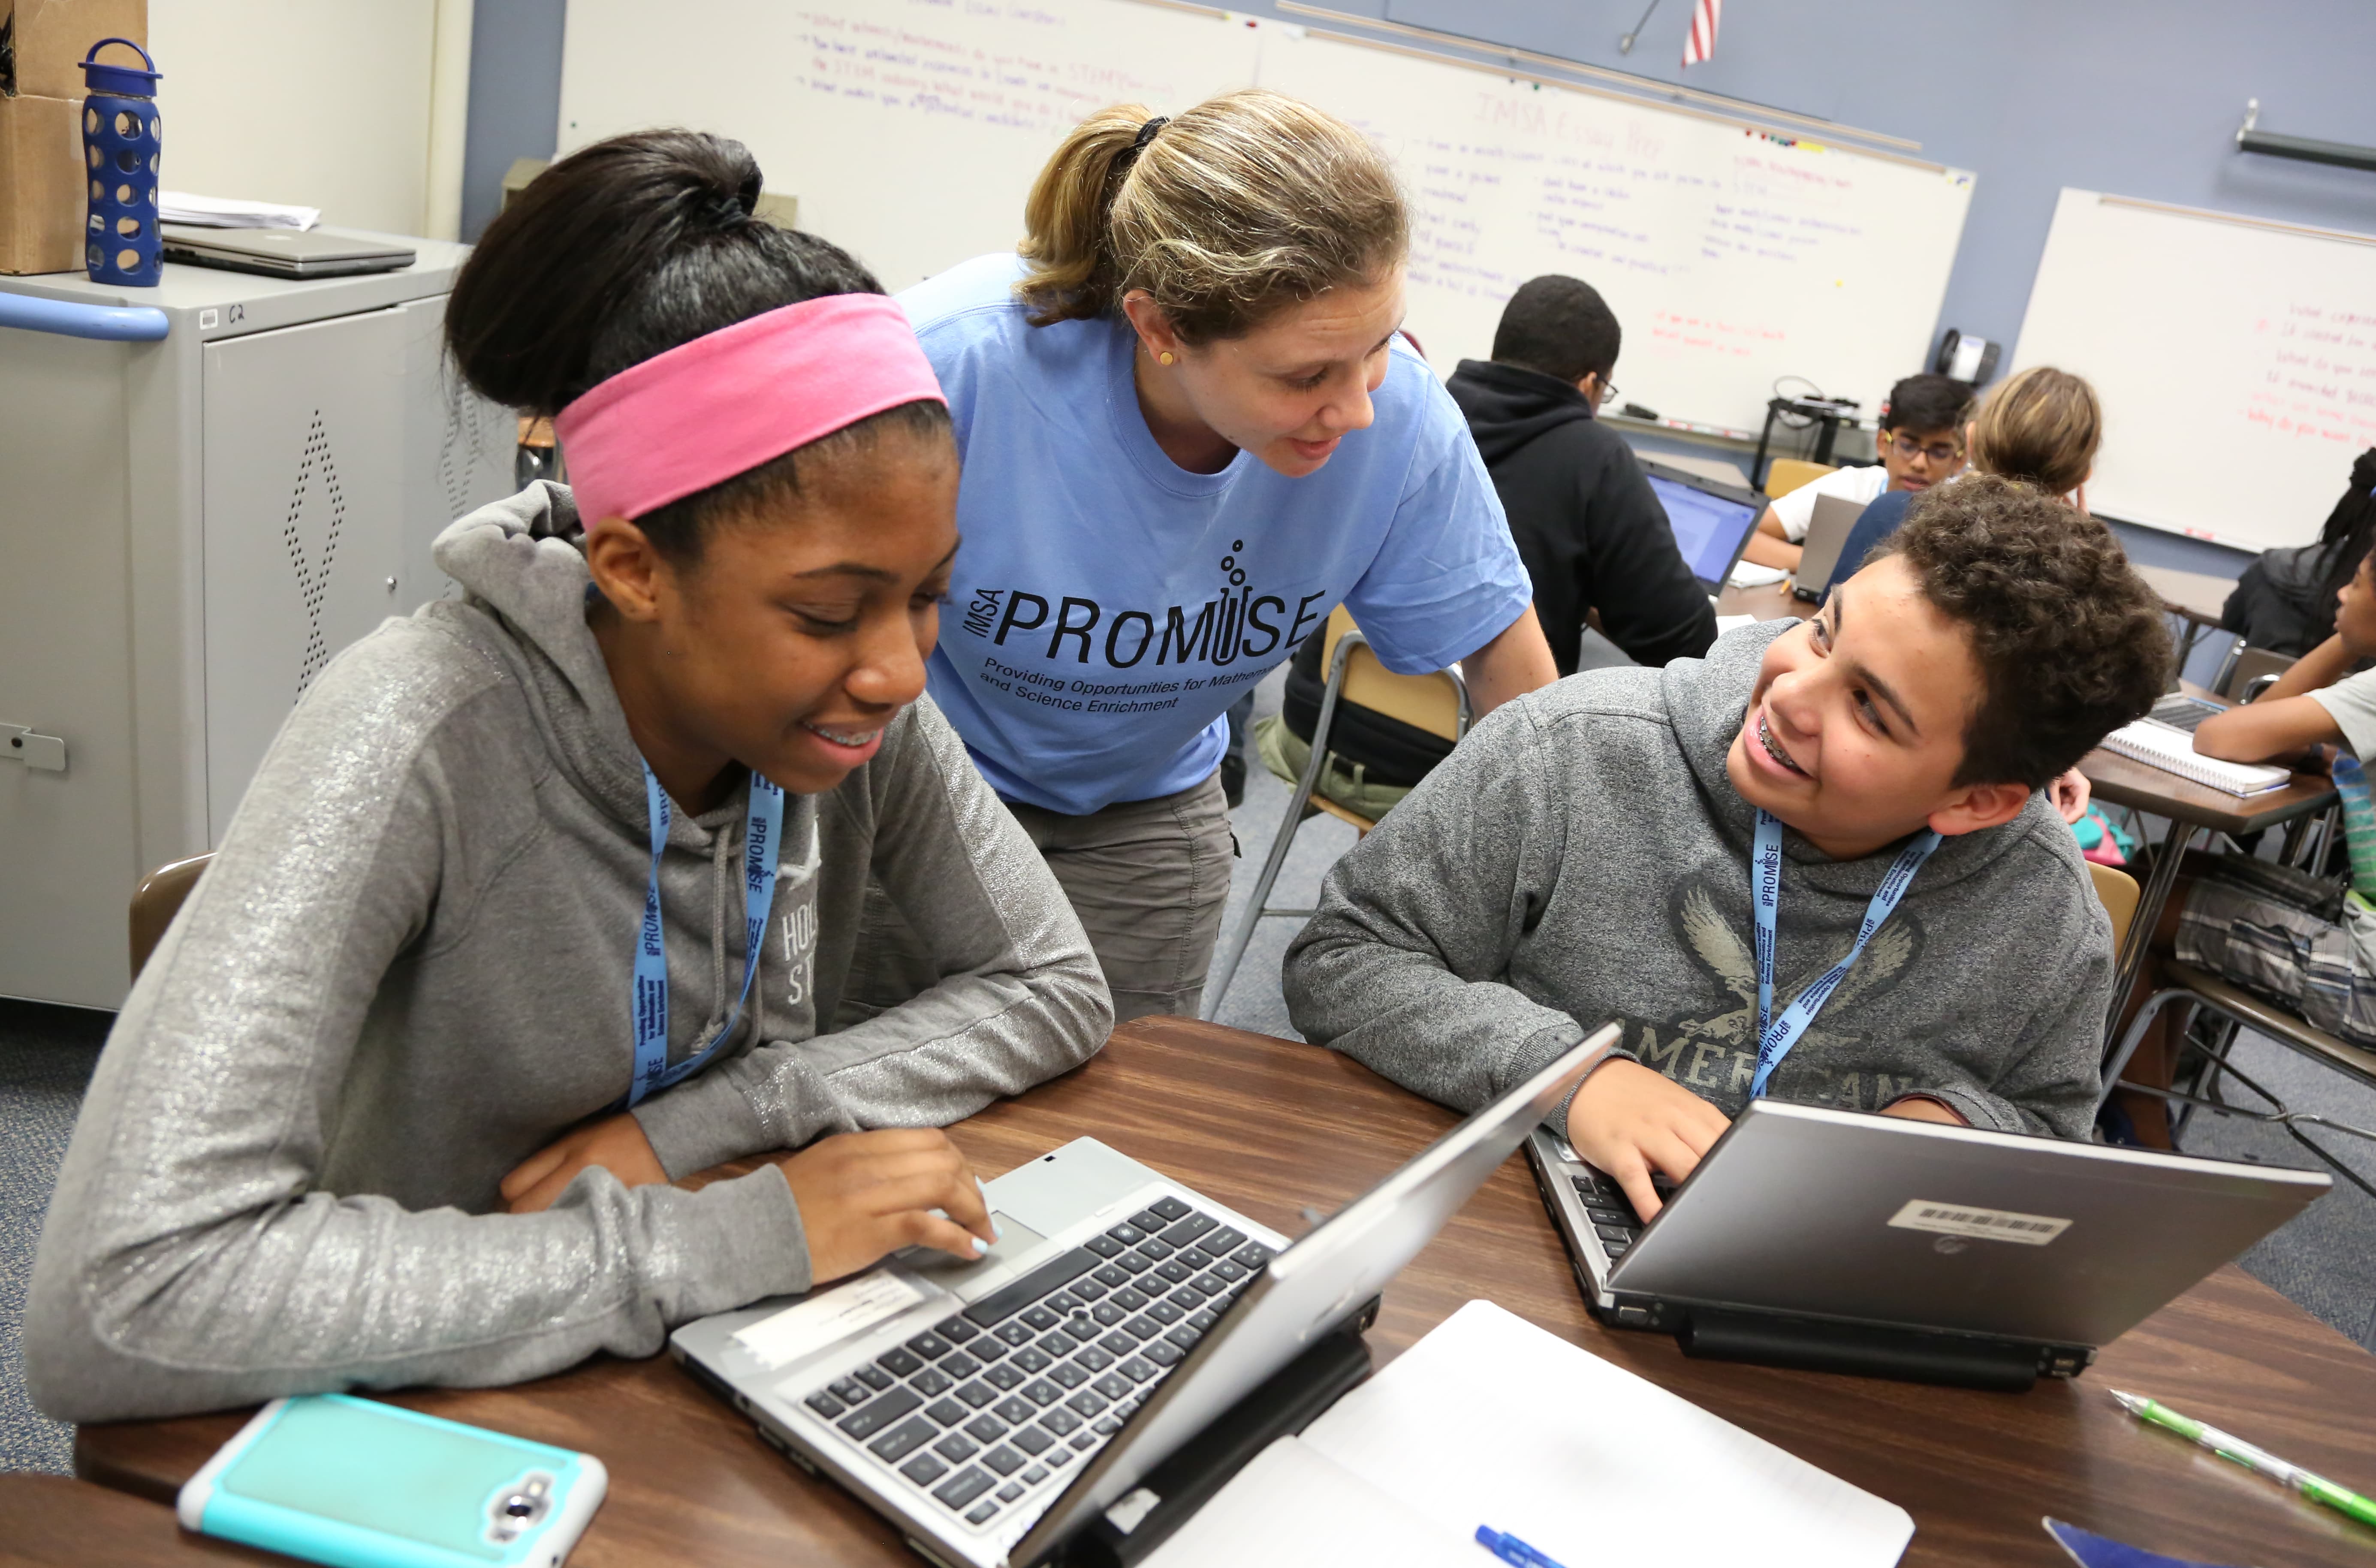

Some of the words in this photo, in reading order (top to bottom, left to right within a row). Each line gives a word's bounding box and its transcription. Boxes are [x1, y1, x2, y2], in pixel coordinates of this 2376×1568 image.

[229, 304, 244, 324] C2
[962, 588, 1004, 639] IMSA
[980, 672, 1012, 692] and
[1015, 686, 1082, 712] Science
[1087, 697, 1179, 713] Enrichment
[985, 657, 1066, 692] Providing
[1071, 680, 1179, 696] Opportunities
[1183, 677, 1207, 691] for
[1762, 844, 1779, 902] PROMISE
[1802, 998, 1811, 1009] and
